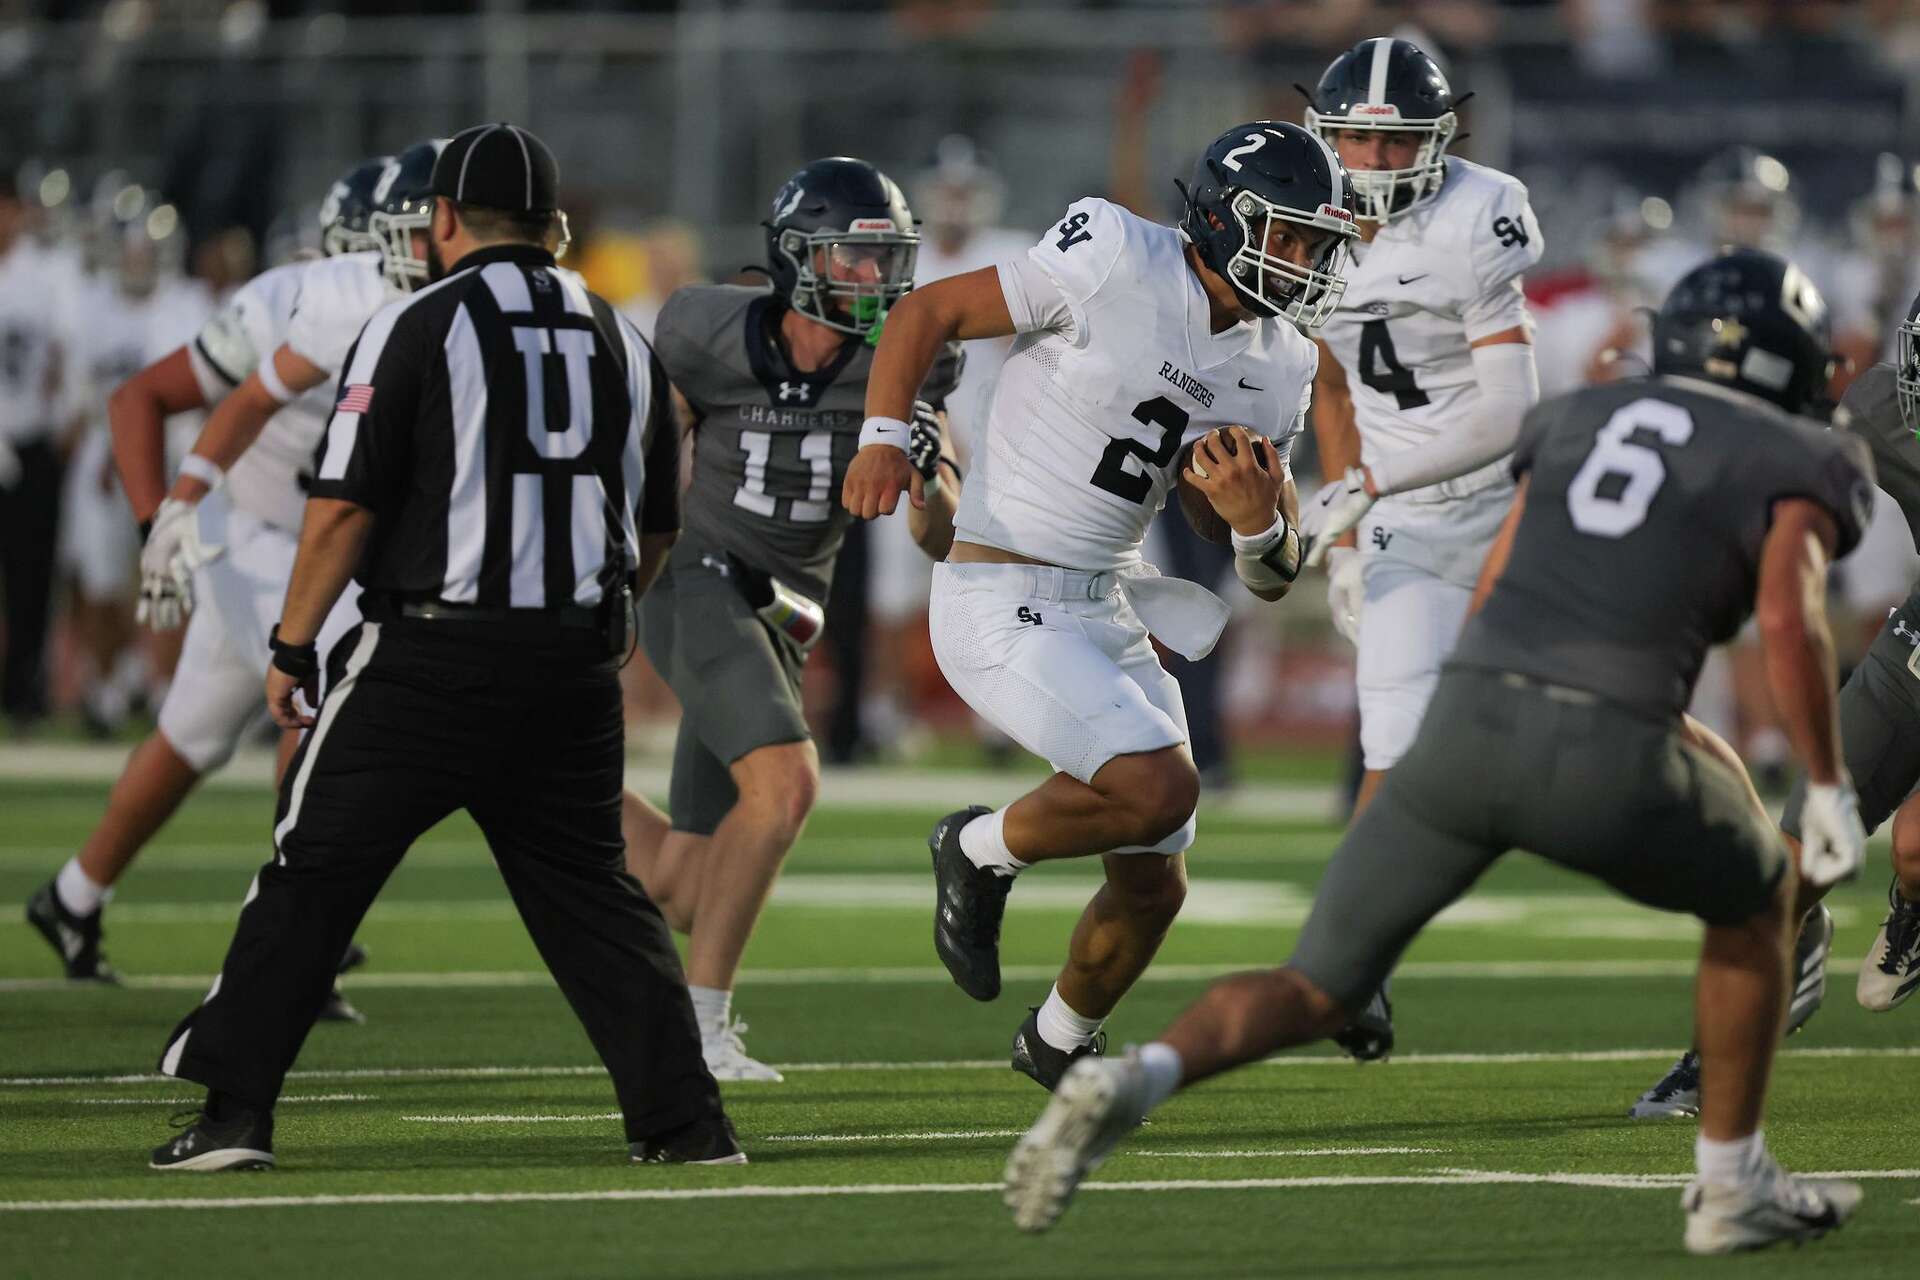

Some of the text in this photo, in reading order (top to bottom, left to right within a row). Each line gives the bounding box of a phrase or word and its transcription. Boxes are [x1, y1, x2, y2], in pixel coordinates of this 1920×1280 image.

[1222, 133, 1266, 172] 2
[1056, 211, 1093, 253] SV
[1324, 206, 1352, 222] Riddell
[1493, 216, 1529, 248] SV
[1158, 360, 1215, 409] RANGERS
[1358, 319, 1431, 411] 4
[512, 326, 596, 460] U
[1089, 394, 1190, 505] 2
[1567, 398, 1694, 539] 6
[733, 430, 832, 522] 11
[1372, 525, 1393, 551] SV
[1017, 606, 1044, 626] SV
